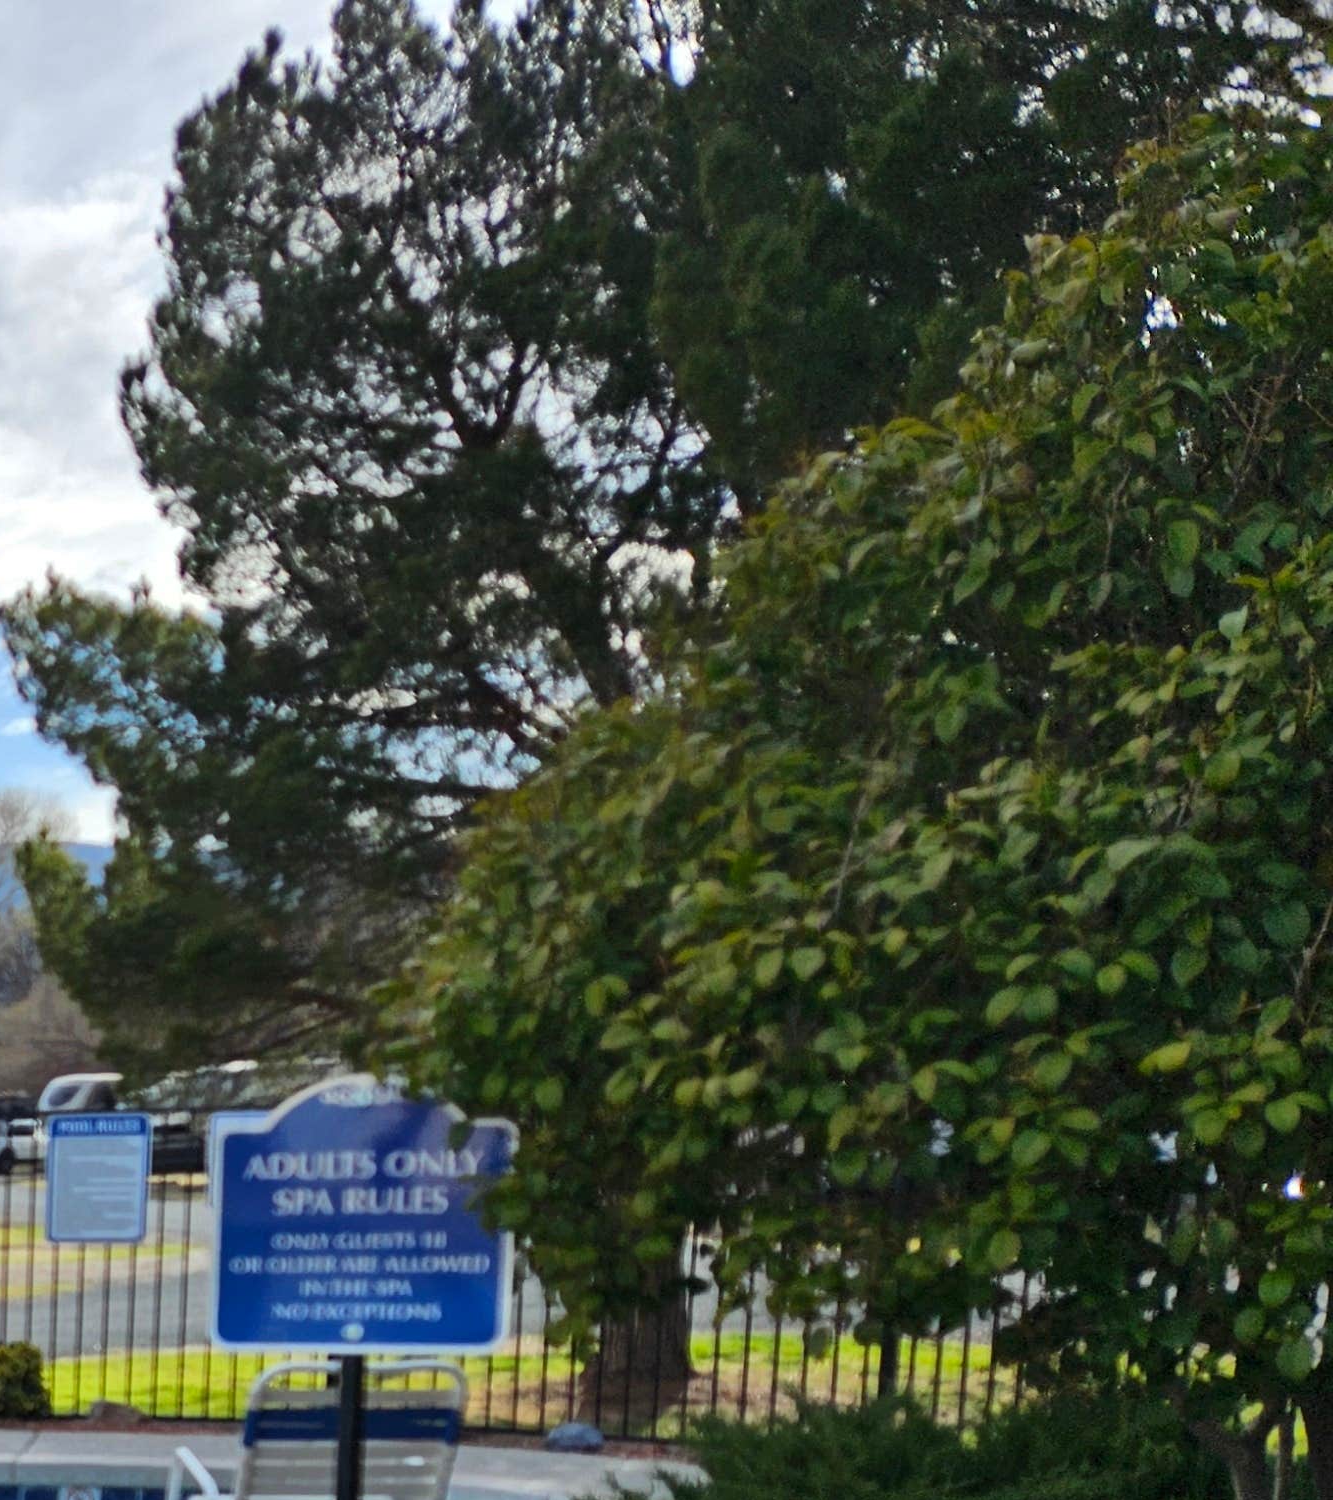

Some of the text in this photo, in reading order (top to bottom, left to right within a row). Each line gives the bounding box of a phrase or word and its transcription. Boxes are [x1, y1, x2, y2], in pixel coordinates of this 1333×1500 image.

[243, 1150, 482, 1181] ADULTS ONLY
[271, 1187, 450, 1216] SPA RULES
[385, 1254, 490, 1274] ALLOWED
